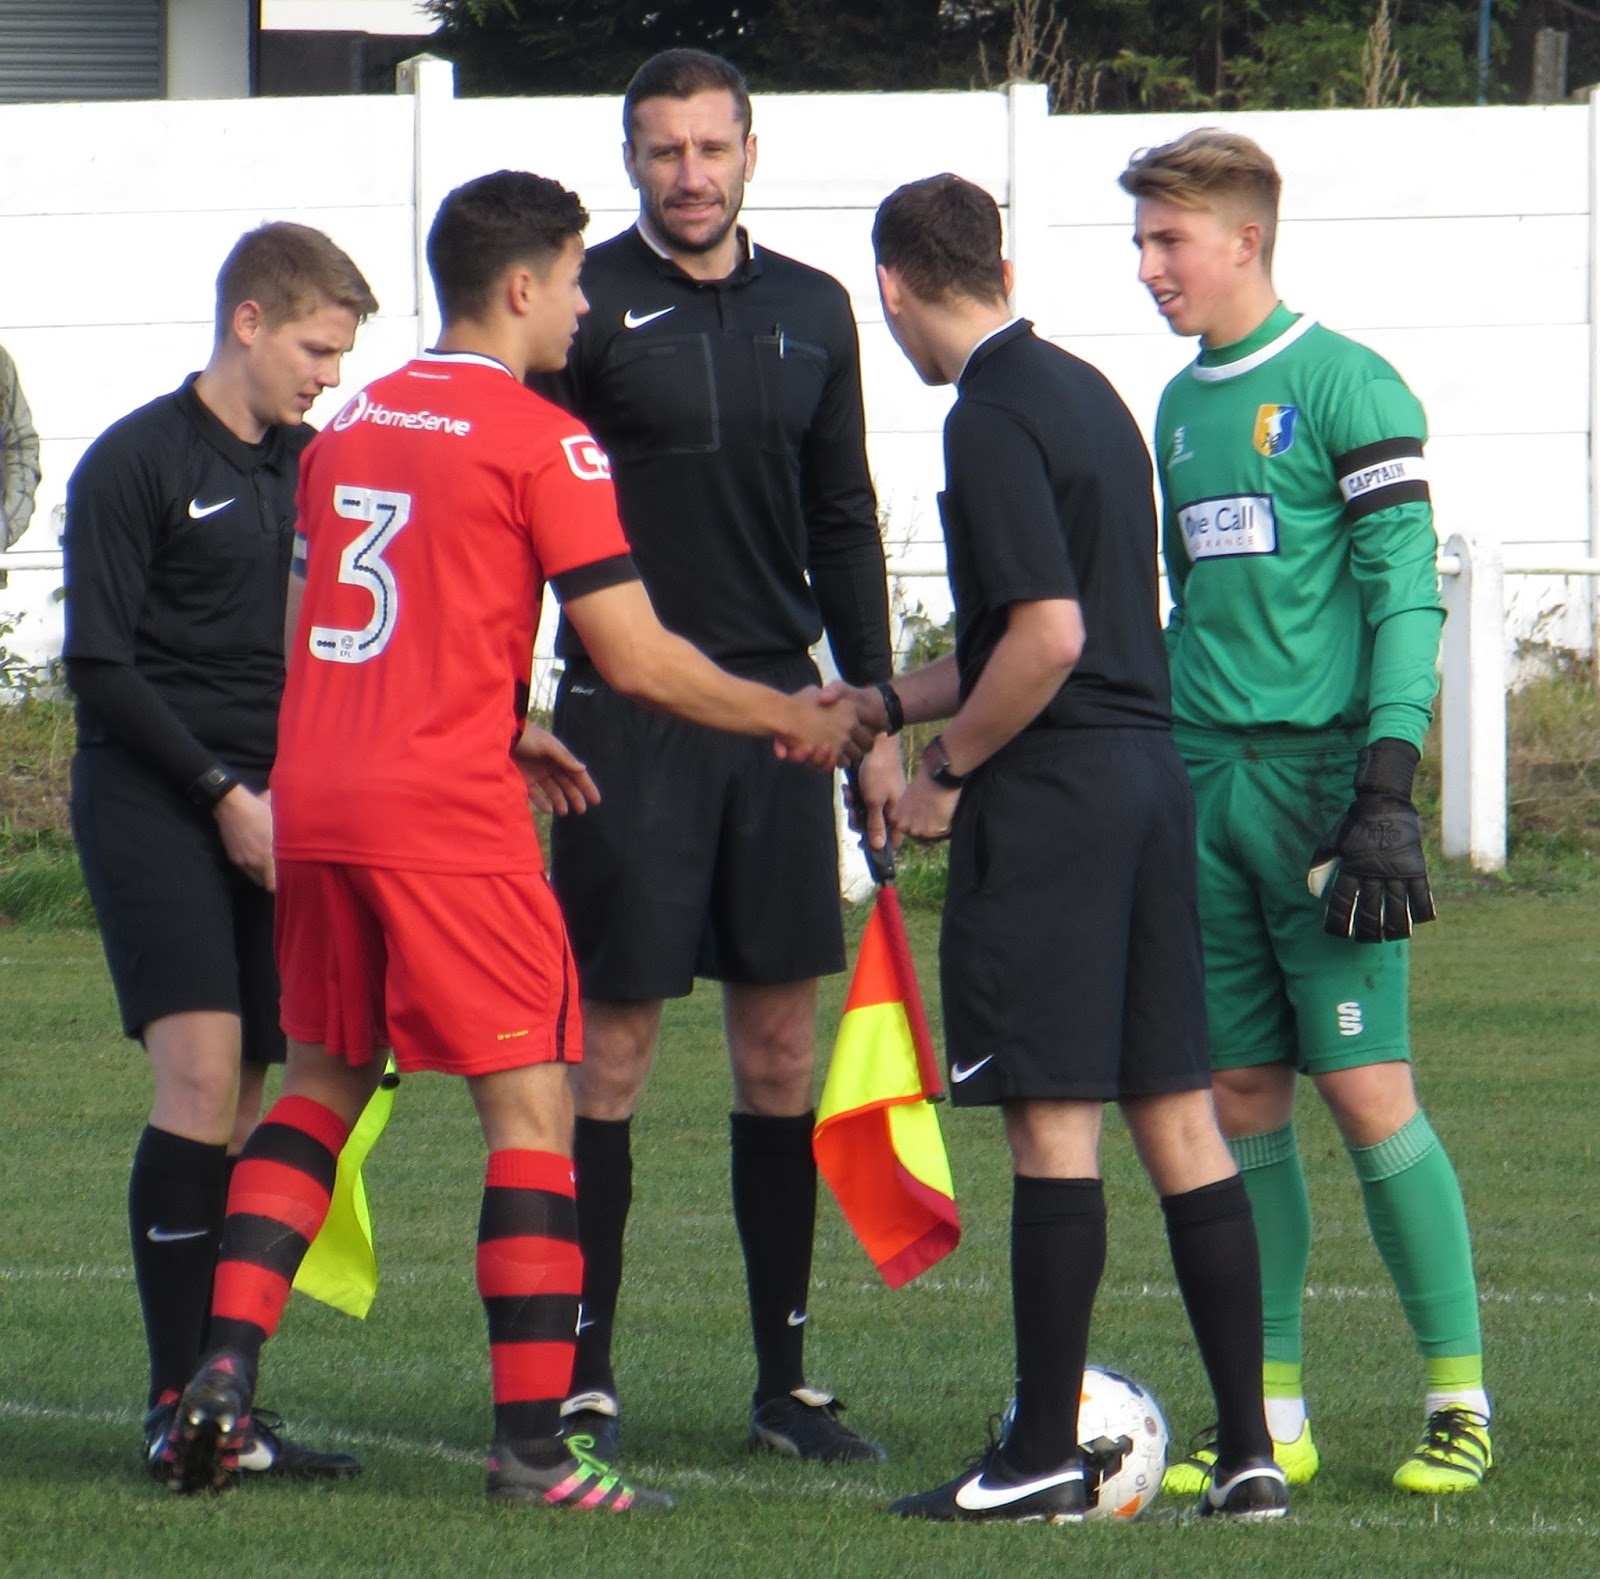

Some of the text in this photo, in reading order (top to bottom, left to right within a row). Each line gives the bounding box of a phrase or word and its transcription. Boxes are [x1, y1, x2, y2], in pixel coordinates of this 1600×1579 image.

[362, 402, 471, 436] HomeServe
[1348, 463, 1406, 494] CAPTAIN
[1185, 505, 1254, 538] Oe Call
[309, 485, 411, 663] 3
